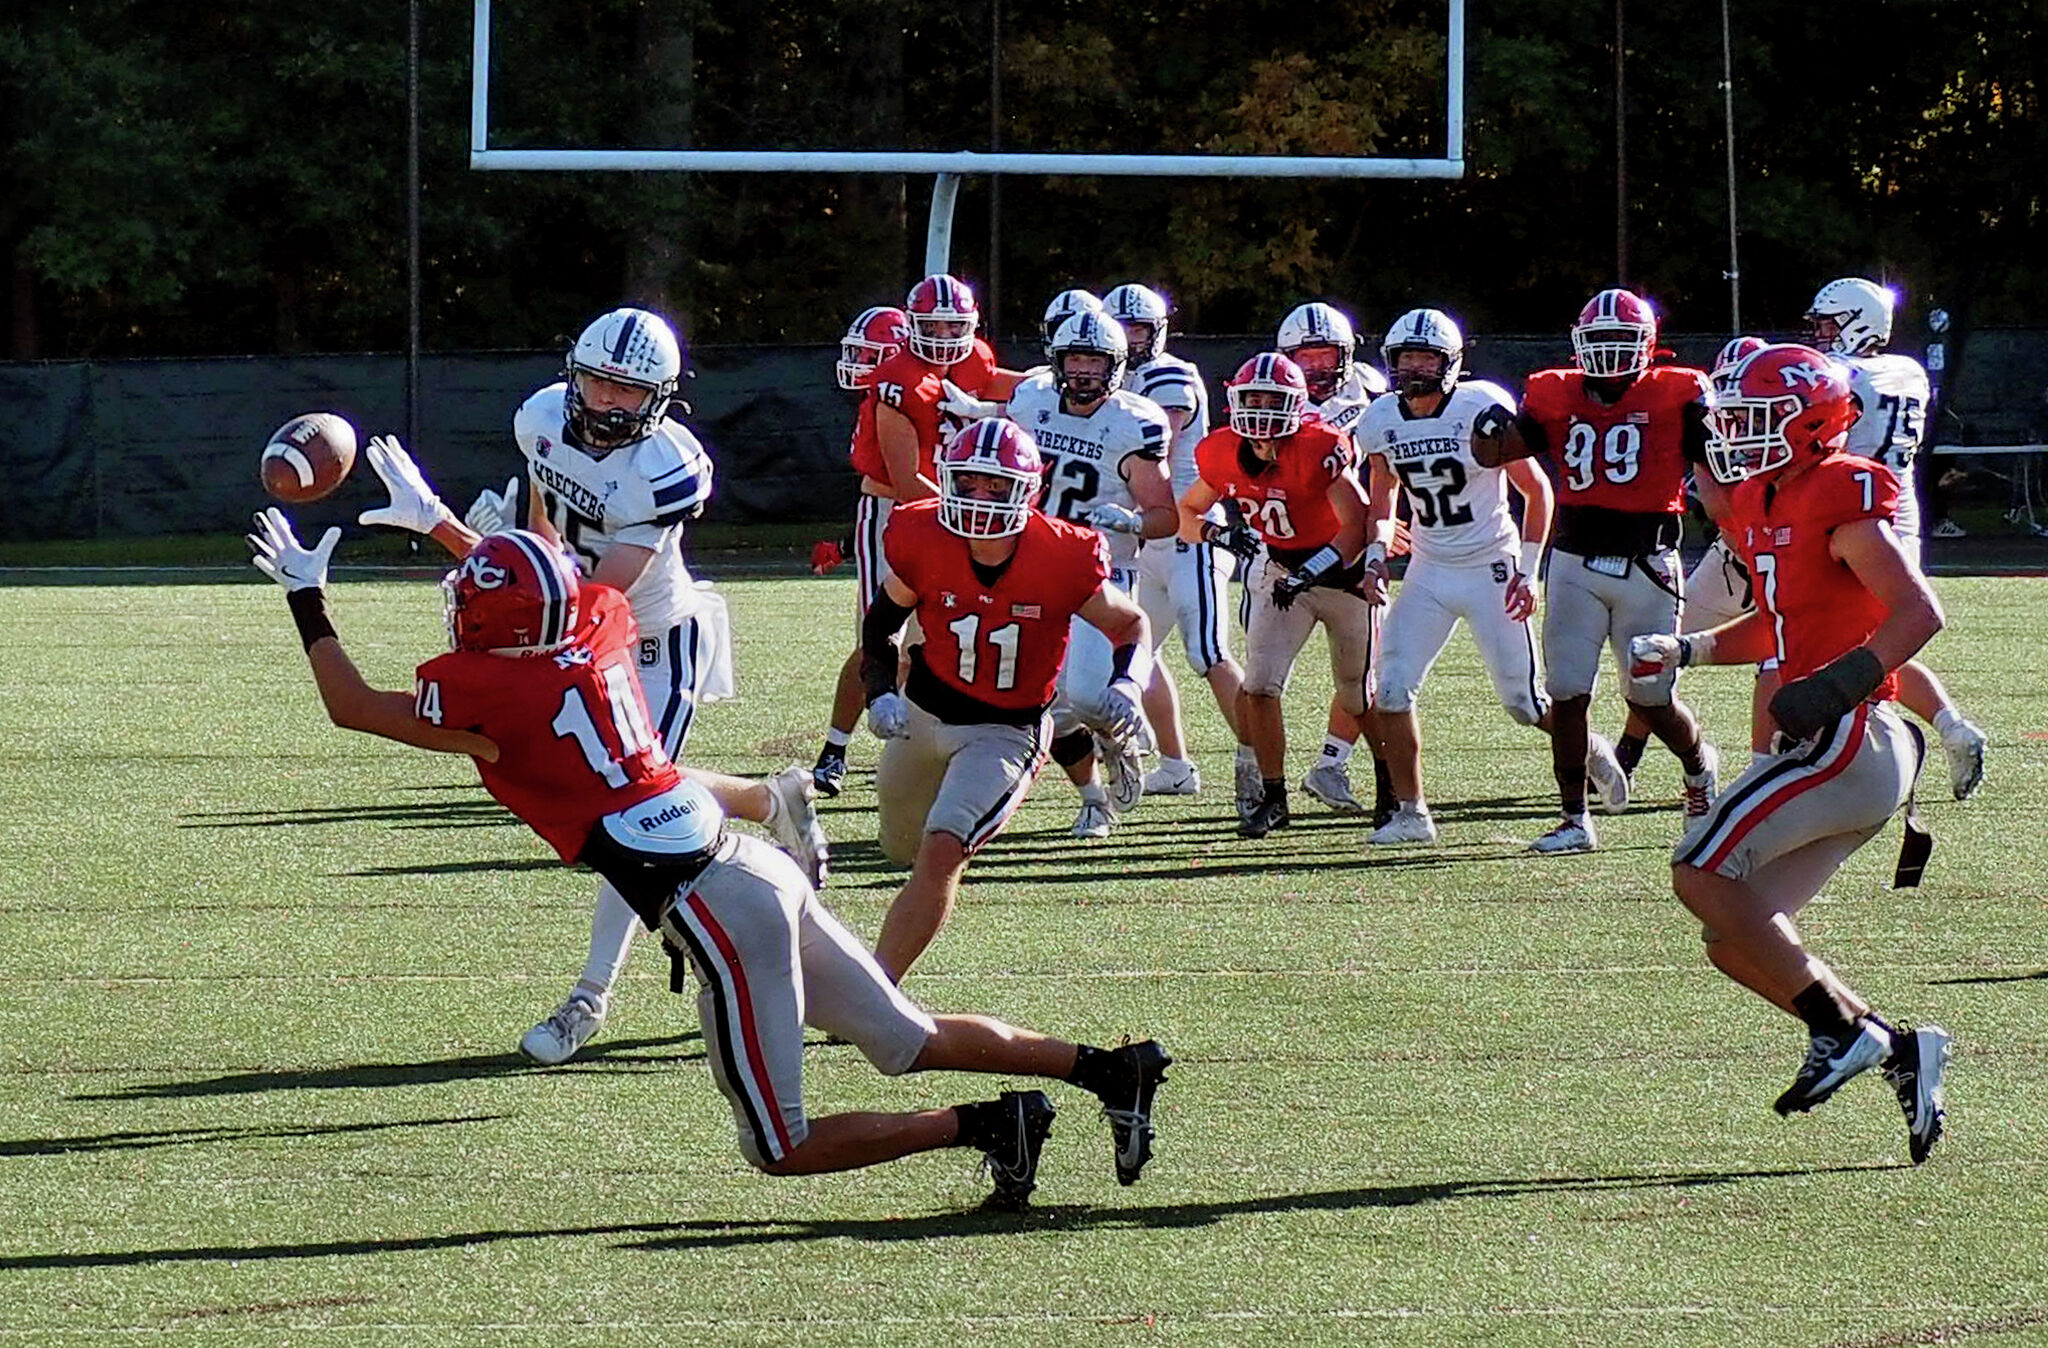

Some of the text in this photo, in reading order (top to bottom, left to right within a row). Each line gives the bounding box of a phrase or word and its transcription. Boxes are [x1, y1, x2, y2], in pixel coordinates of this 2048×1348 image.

[878, 382, 904, 407] 15
[1565, 423, 1640, 491] 99
[1394, 457, 1475, 528] 52
[1854, 472, 1872, 511] 7
[460, 556, 506, 589] NC
[1491, 561, 1508, 583] S
[1755, 554, 1786, 661] 7
[638, 637, 660, 668] S
[949, 614, 1020, 689] 11
[413, 678, 443, 725] 14
[552, 663, 668, 790] 14
[639, 799, 700, 832] Riddell
